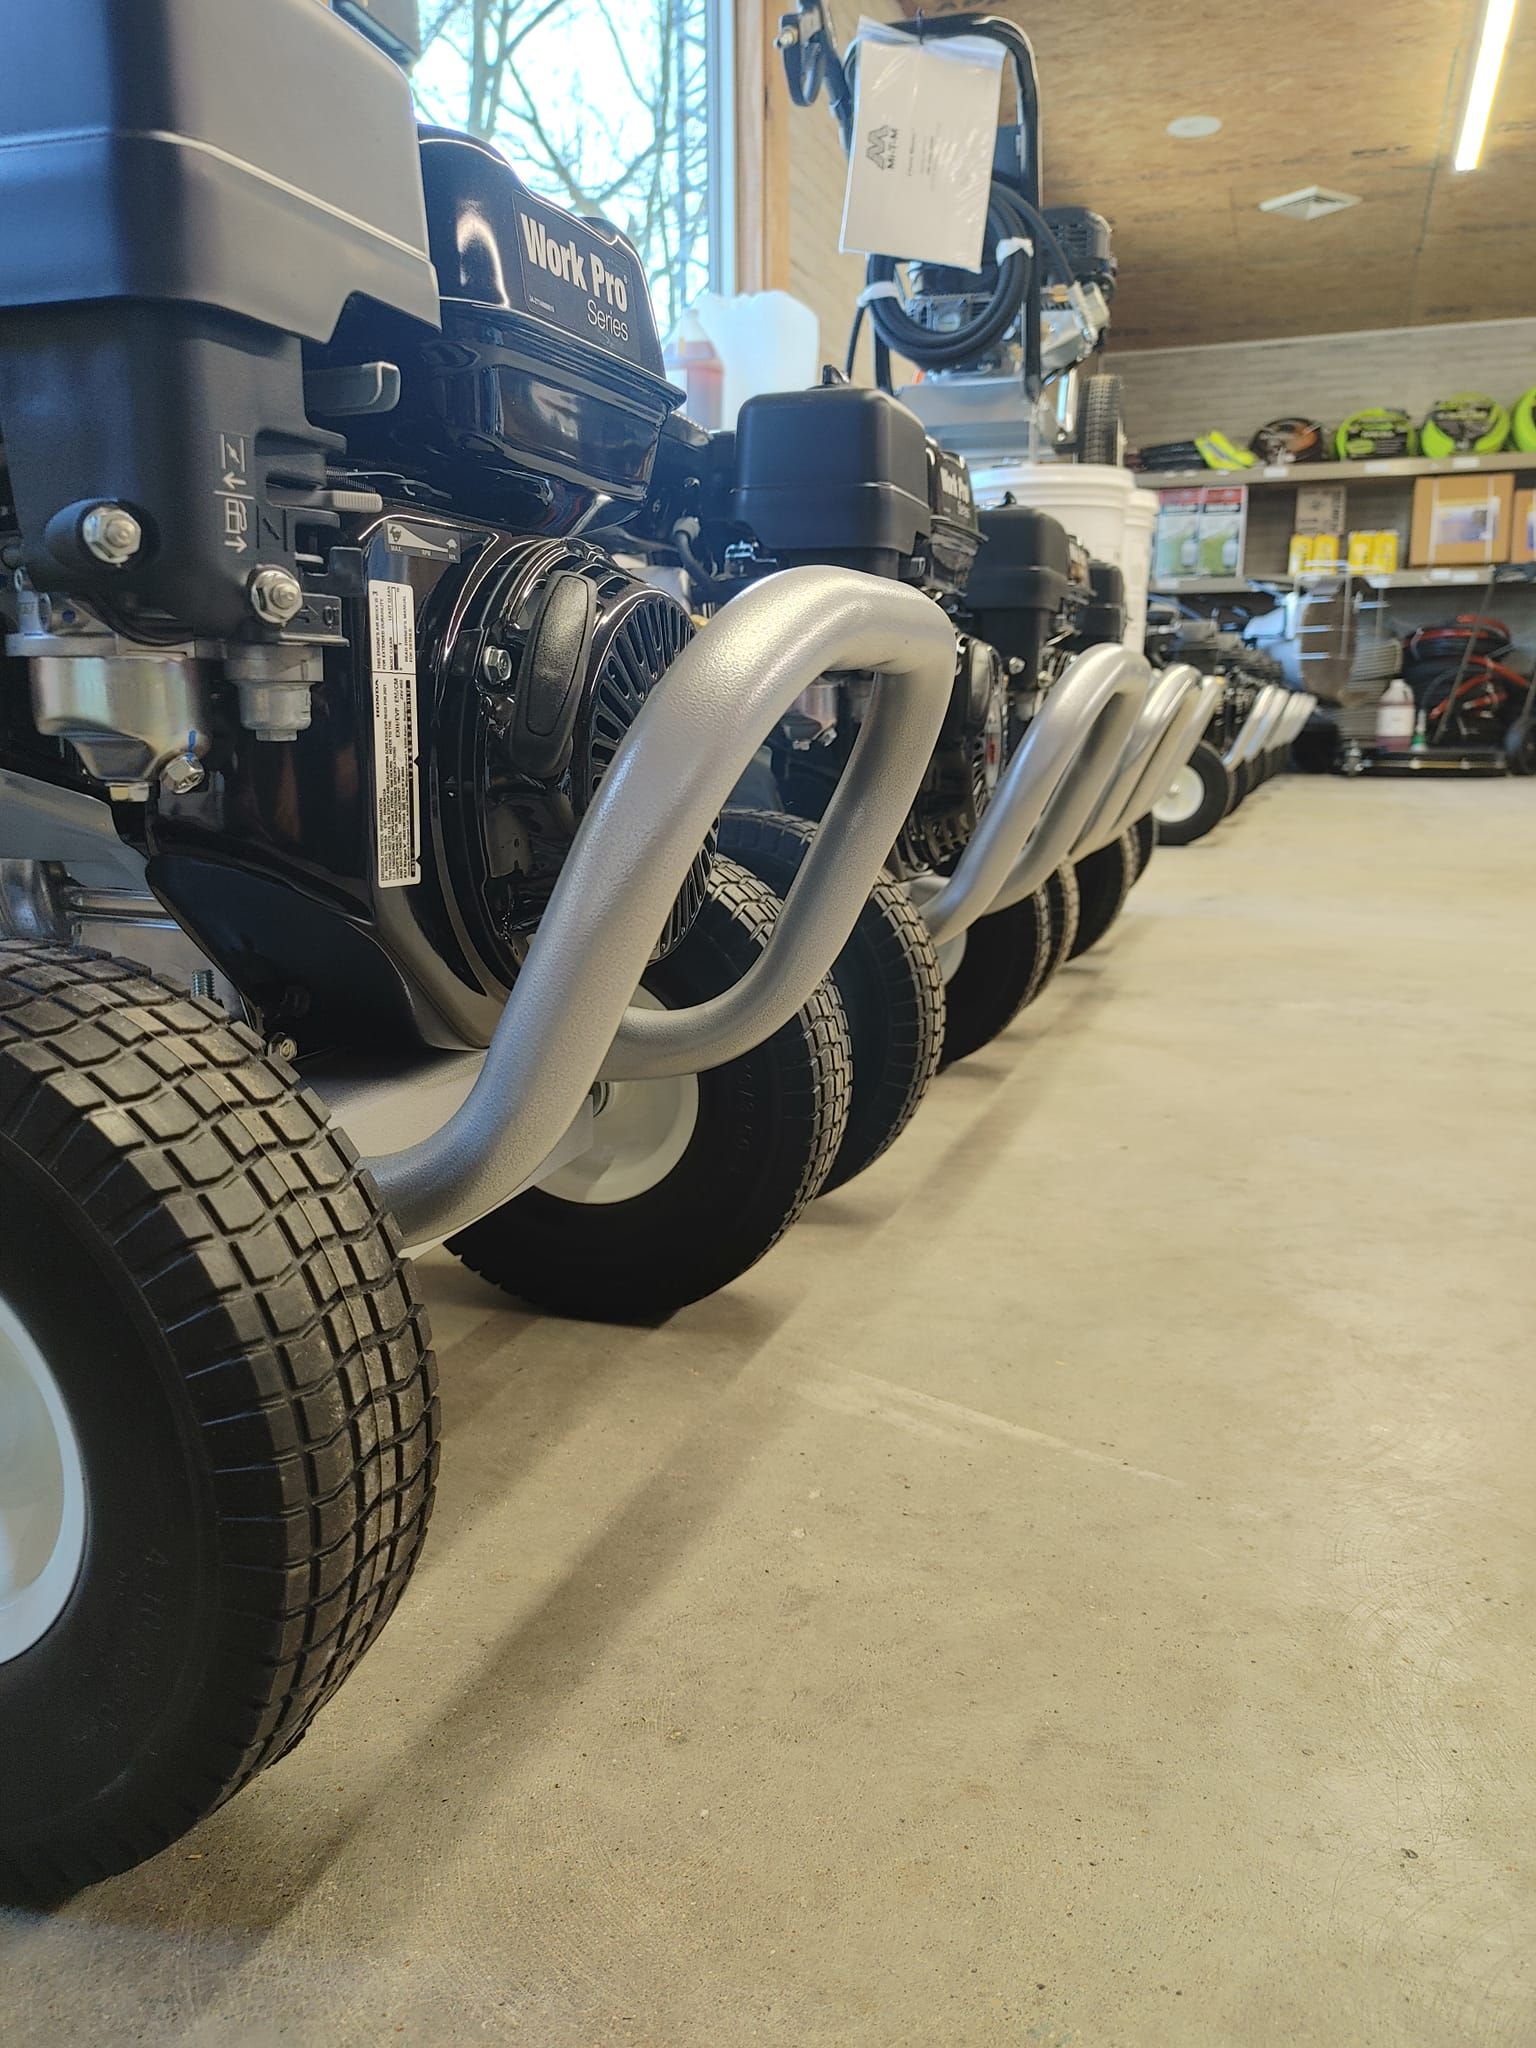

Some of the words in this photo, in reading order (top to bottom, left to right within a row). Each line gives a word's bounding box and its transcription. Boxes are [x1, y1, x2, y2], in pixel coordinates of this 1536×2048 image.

[520, 212, 588, 292] Work
[590, 252, 628, 313] Pro
[587, 299, 629, 342] Series
